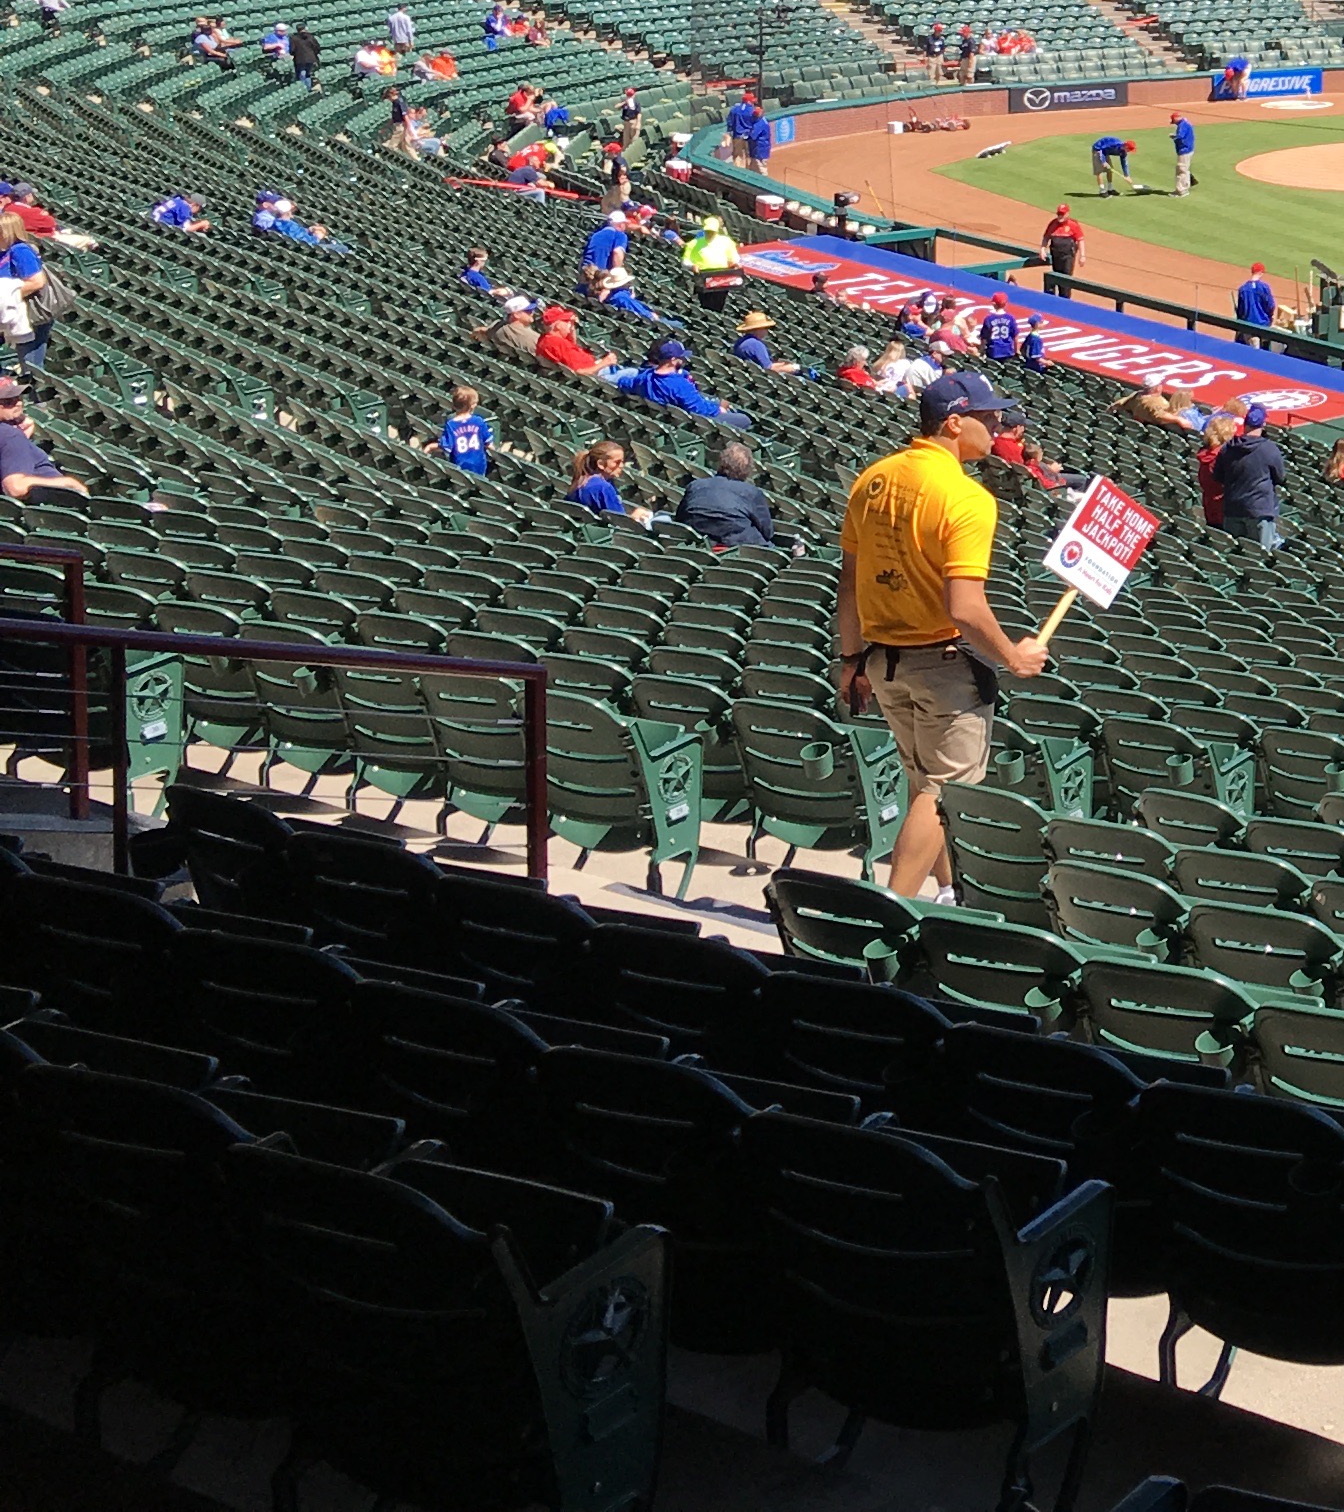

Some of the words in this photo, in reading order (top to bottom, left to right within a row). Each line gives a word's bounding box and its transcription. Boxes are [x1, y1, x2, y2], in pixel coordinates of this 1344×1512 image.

[991, 326, 1009, 340] 29
[456, 434, 480, 453] 84
[1091, 505, 1122, 532] HALF
[1119, 524, 1142, 550] THE
[1096, 485, 1126, 516] TAKE
[1122, 506, 1155, 540] HOME
[1082, 521, 1133, 563] JACKPOT!
[1085, 557, 1119, 584] FOUNDATION
